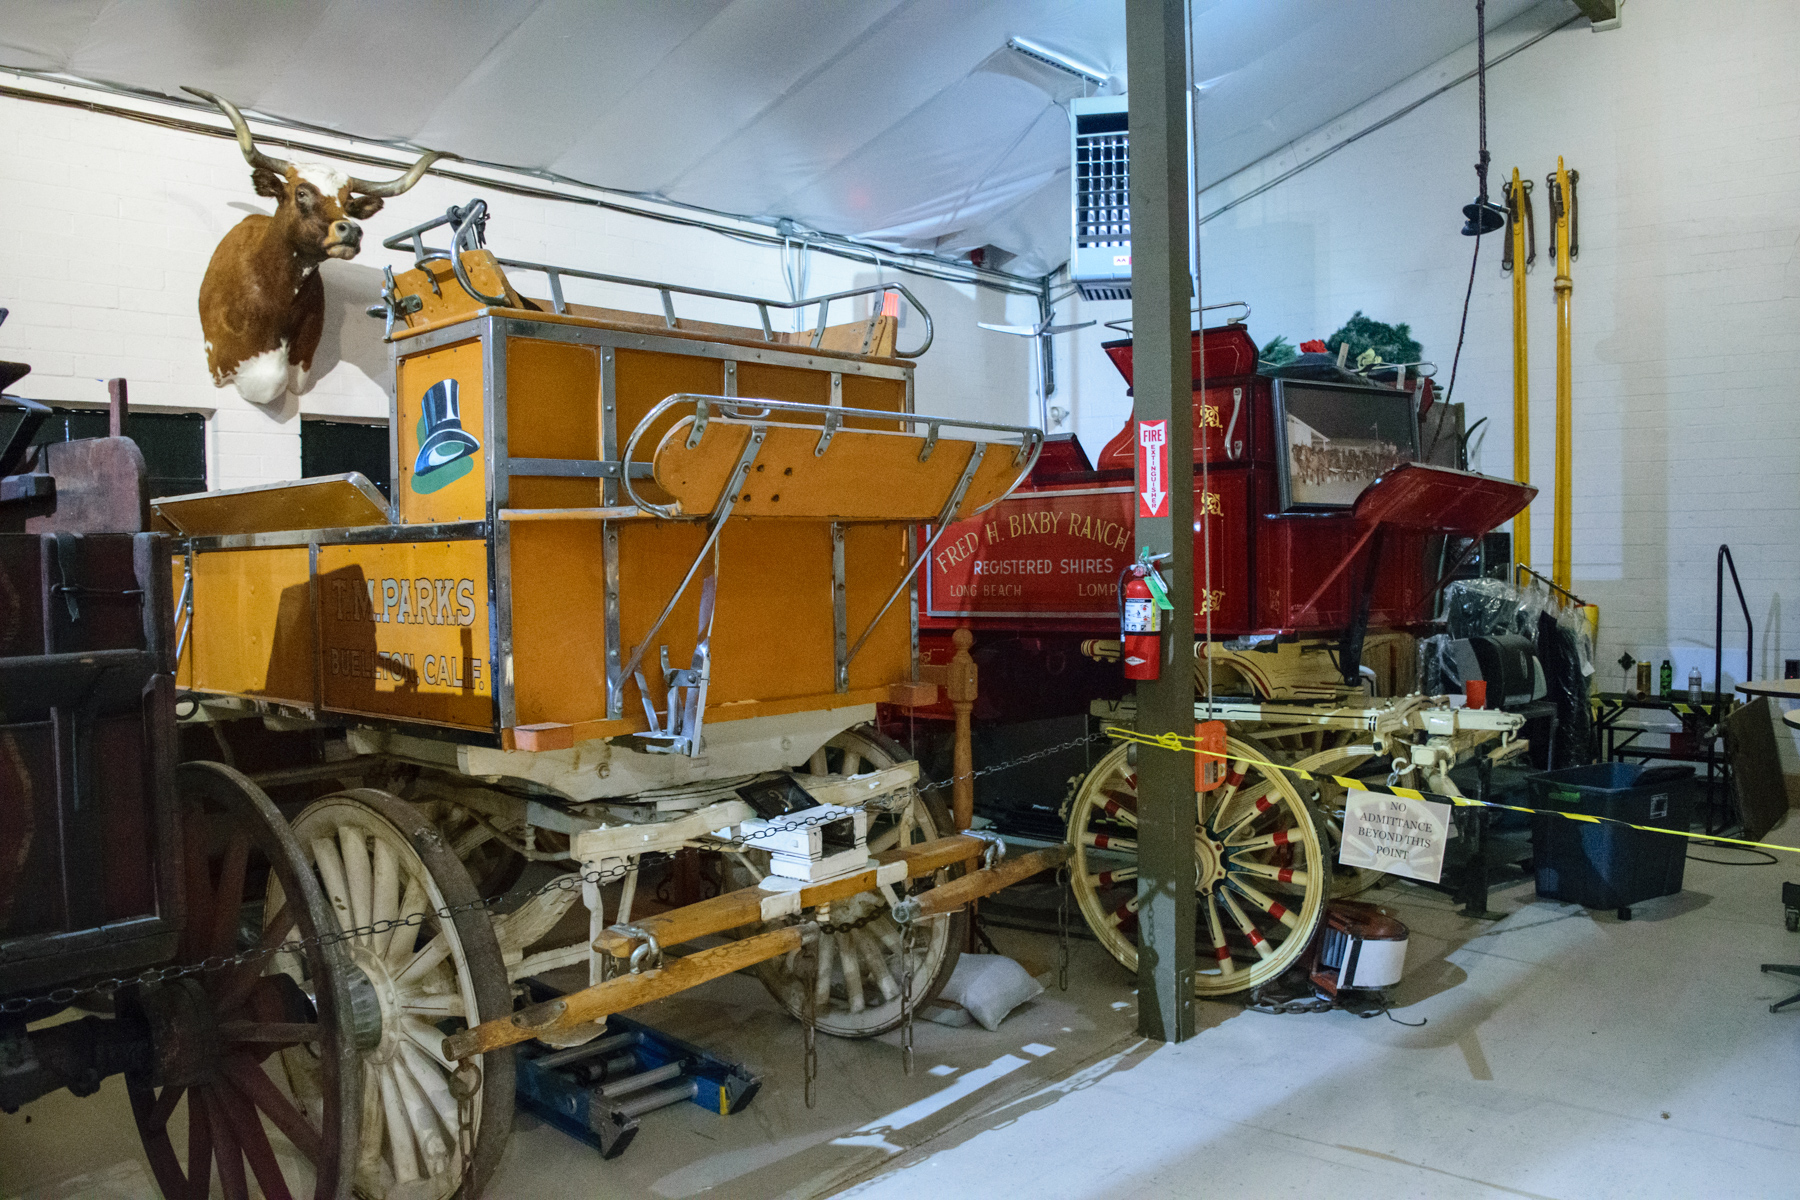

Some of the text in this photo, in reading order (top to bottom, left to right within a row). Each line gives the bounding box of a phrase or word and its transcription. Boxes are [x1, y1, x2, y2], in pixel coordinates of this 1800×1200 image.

[1143, 429, 1162, 442] FIRE
[936, 532, 979, 574] FRED
[1008, 511, 1063, 538] BIXBY
[1068, 513, 1131, 552] RANCH
[974, 558, 1114, 575] REGISTERED SHIRES
[950, 584, 977, 597] LONG
[984, 584, 1022, 597] BEACH
[423, 654, 485, 691] CALIF.
[1390, 801, 1407, 813] NO
[1359, 812, 1433, 833] ADMITTANCE
[1358, 826, 1431, 849] BEYOND THIS
[1376, 845, 1410, 860] POINT
